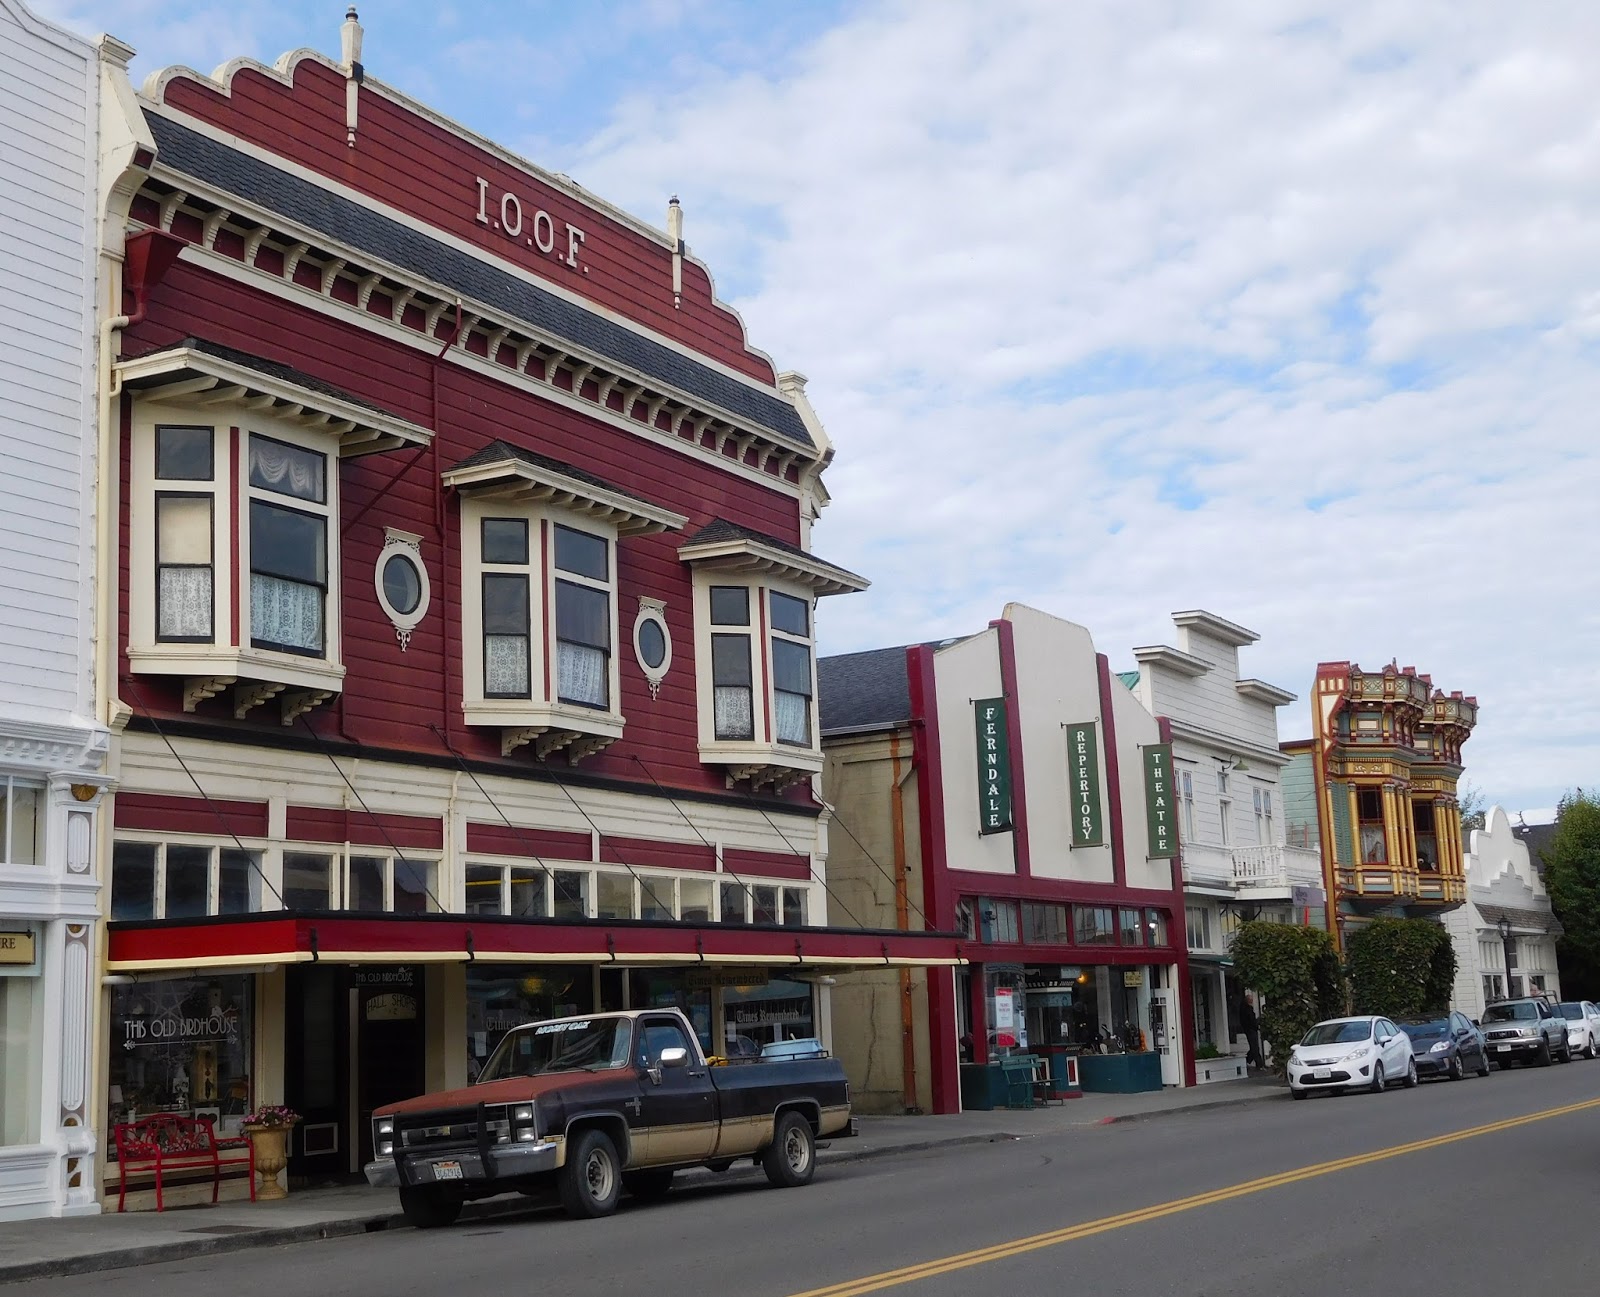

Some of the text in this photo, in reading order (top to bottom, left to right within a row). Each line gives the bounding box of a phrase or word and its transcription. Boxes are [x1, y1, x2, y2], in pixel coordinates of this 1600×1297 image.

[476, 176, 588, 273] I.O.O.F.
[985, 707, 999, 826] FERNDALE
[1077, 730, 1092, 839] REPERTORY
[1152, 753, 1167, 850] THEATRE
[368, 972, 381, 982] OLD
[736, 1008, 800, 1023] Times Remembered
[124, 1016, 238, 1039] THIS OLD BIRDHOUSE
